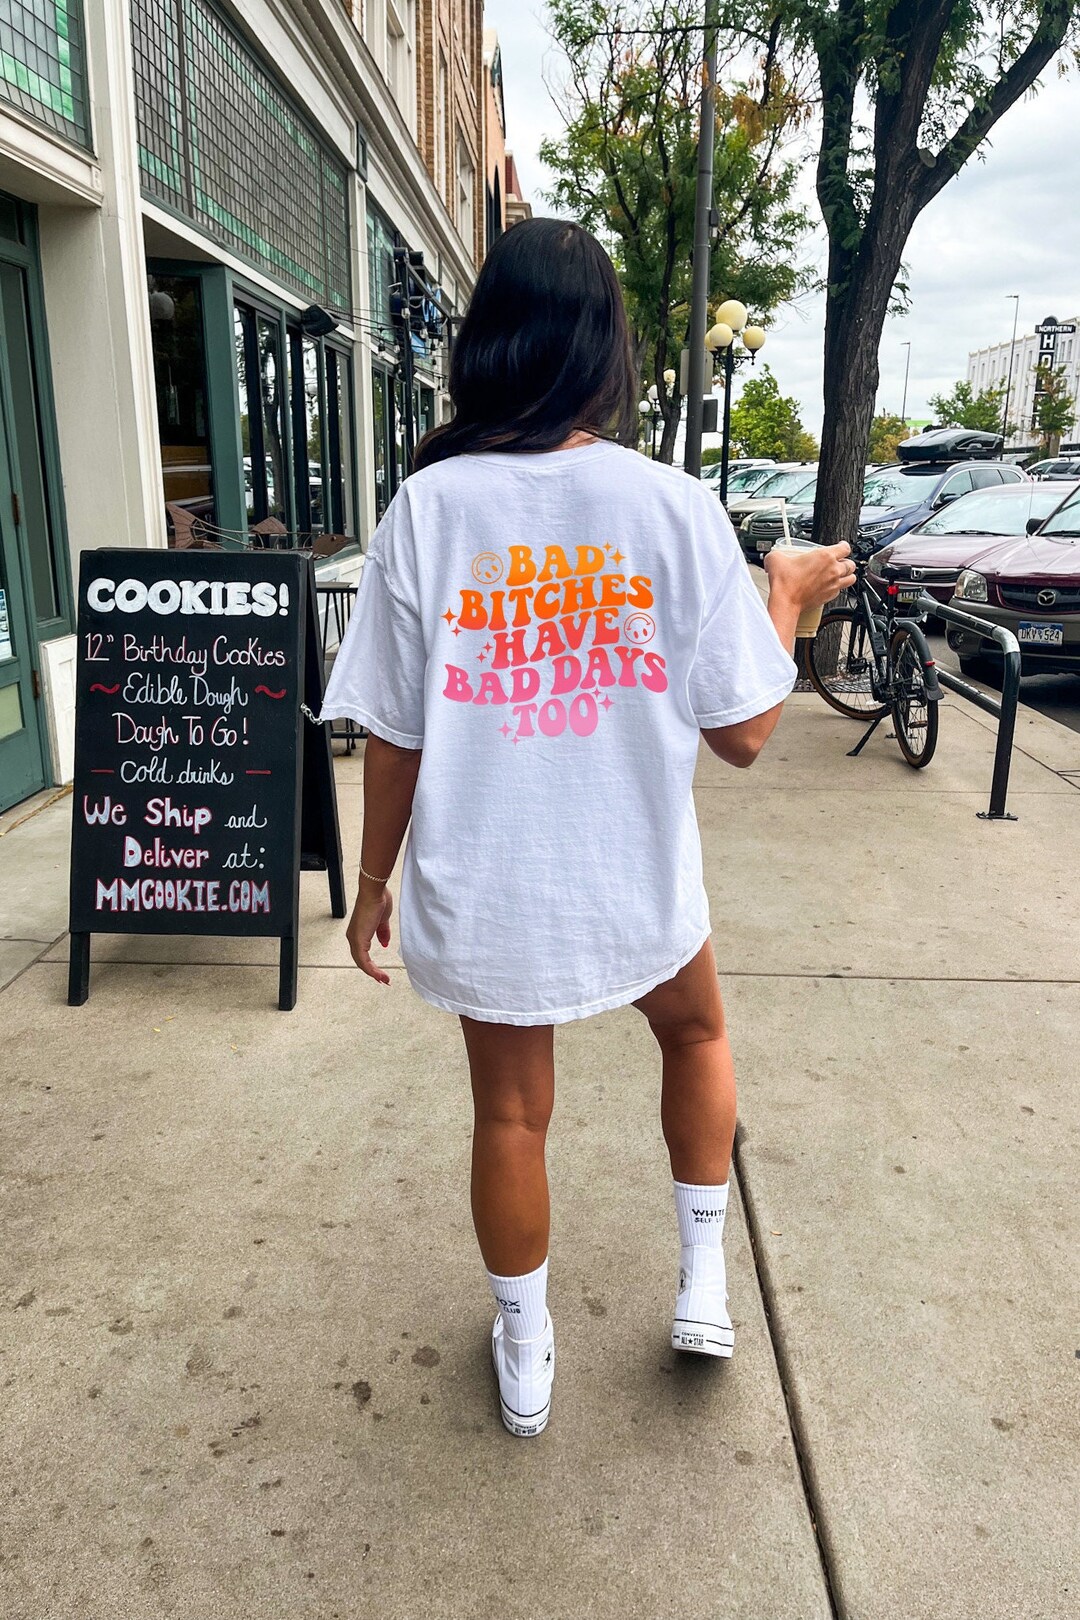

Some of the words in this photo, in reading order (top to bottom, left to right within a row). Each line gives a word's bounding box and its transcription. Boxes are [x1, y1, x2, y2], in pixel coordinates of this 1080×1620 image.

[1039, 325, 1073, 333] NORTHERN
[506, 545, 605, 587] BAD
[86, 578, 289, 617] COOKIES!
[457, 573, 654, 632] BITCHES
[123, 633, 208, 676] Birthday
[491, 607, 620, 670] HAVE
[122, 672, 187, 705] Edible
[189, 675, 249, 714] Dough
[443, 664, 541, 706] BAD
[550, 645, 668, 693] DAYS
[111, 712, 180, 751] Dough
[182, 716, 204, 745] To
[512, 692, 599, 737] TOO
[120, 756, 174, 784] Cold
[83, 795, 127, 826] We
[144, 796, 212, 835] Ship
[224, 804, 267, 829] and
[123, 835, 209, 868] Deliver
[222, 843, 265, 869] at:
[95, 878, 271, 914] MMCOOKIE.COM
